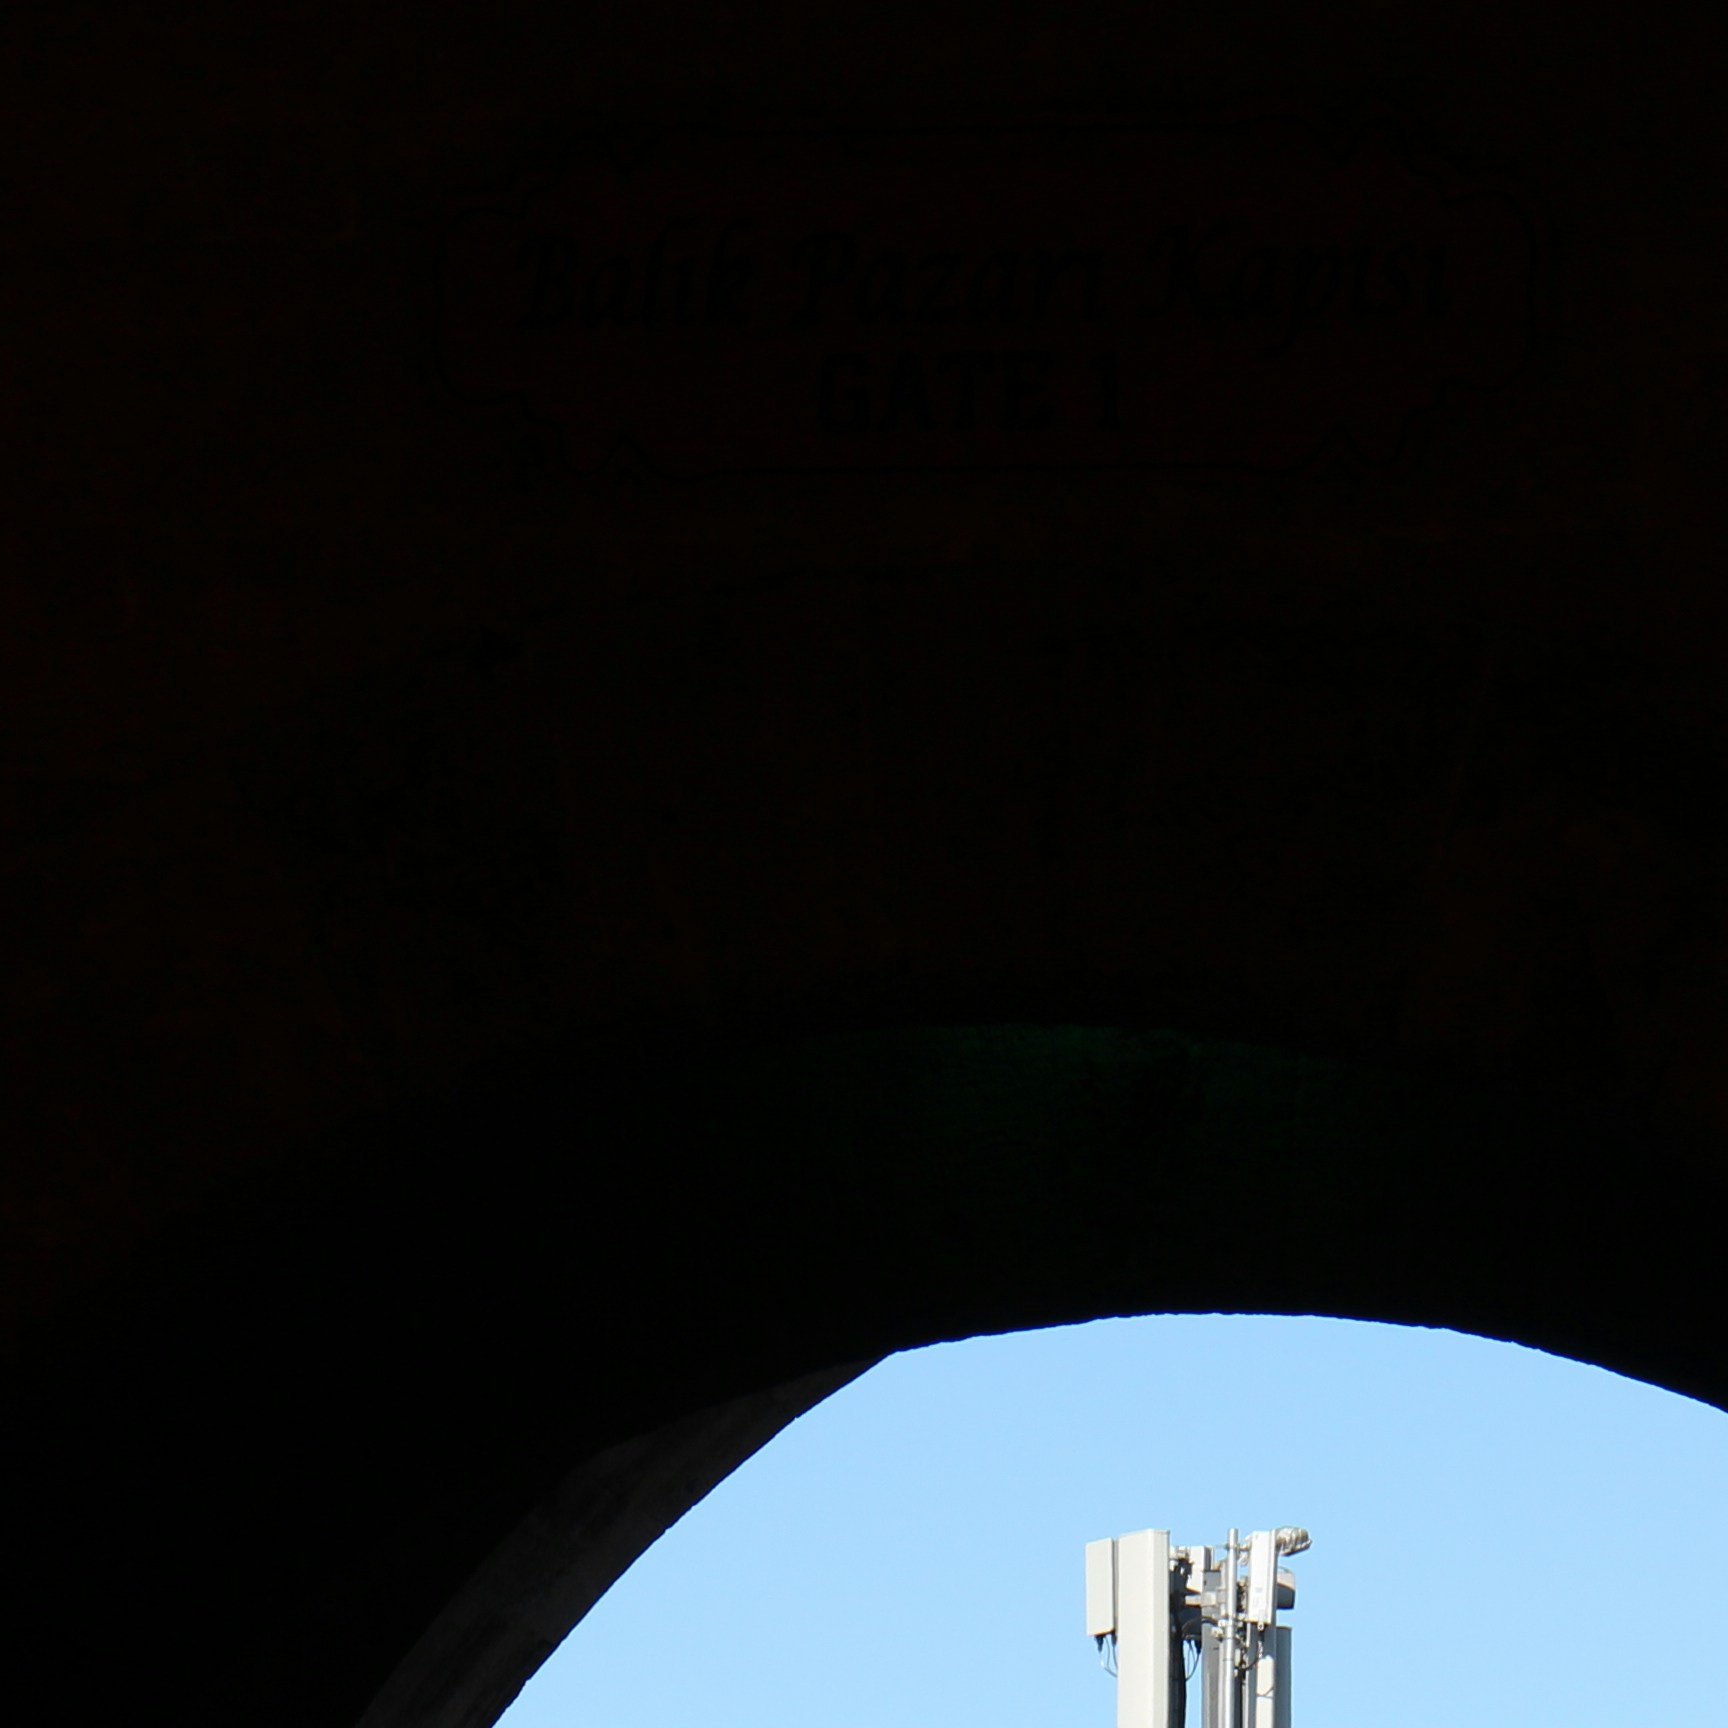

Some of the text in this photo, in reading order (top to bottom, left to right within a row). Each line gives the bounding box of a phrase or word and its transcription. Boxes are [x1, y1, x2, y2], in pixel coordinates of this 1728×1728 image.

[515, 217, 1452, 357] Balık Pazarı Kapısı
[818, 350, 1121, 432] GATE 1
